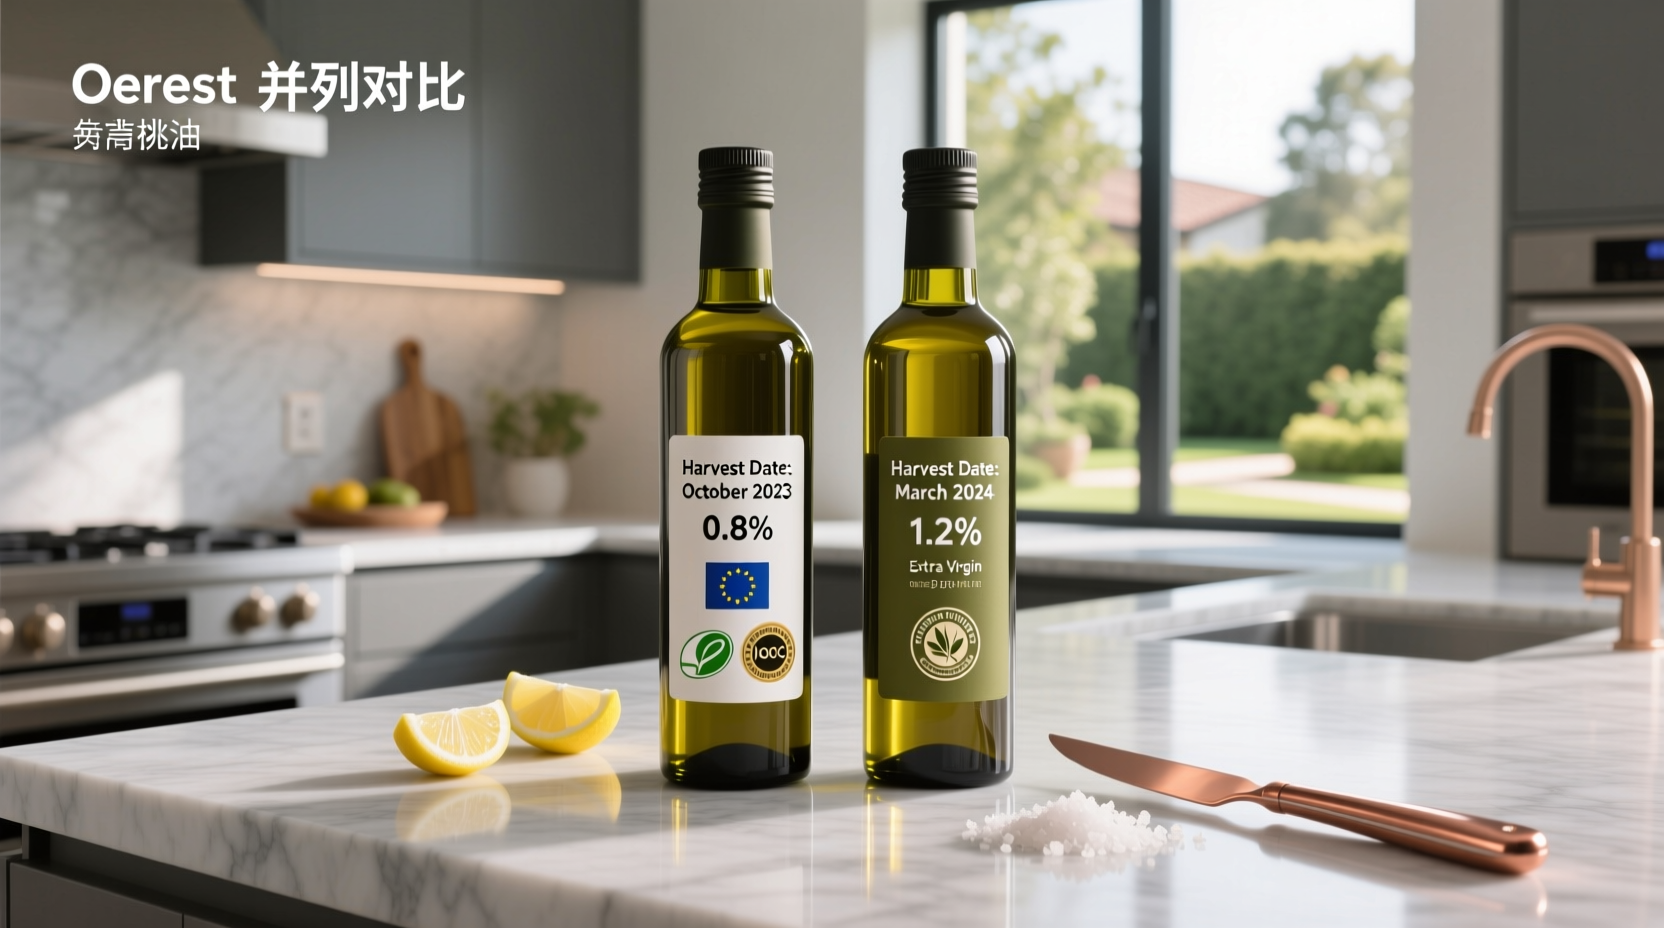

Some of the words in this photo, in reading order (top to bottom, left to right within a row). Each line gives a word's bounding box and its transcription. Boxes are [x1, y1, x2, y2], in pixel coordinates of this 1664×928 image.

[682, 459, 745, 476] Harvest
[750, 460, 793, 476] Date:
[890, 460, 954, 477] Harvest
[958, 460, 1000, 477] Date:
[682, 482, 748, 500] October
[753, 482, 793, 500] 2023
[895, 483, 948, 501] March
[952, 483, 995, 501] 2024
[702, 514, 773, 541] 0.8%
[910, 516, 983, 546] 1.2%
